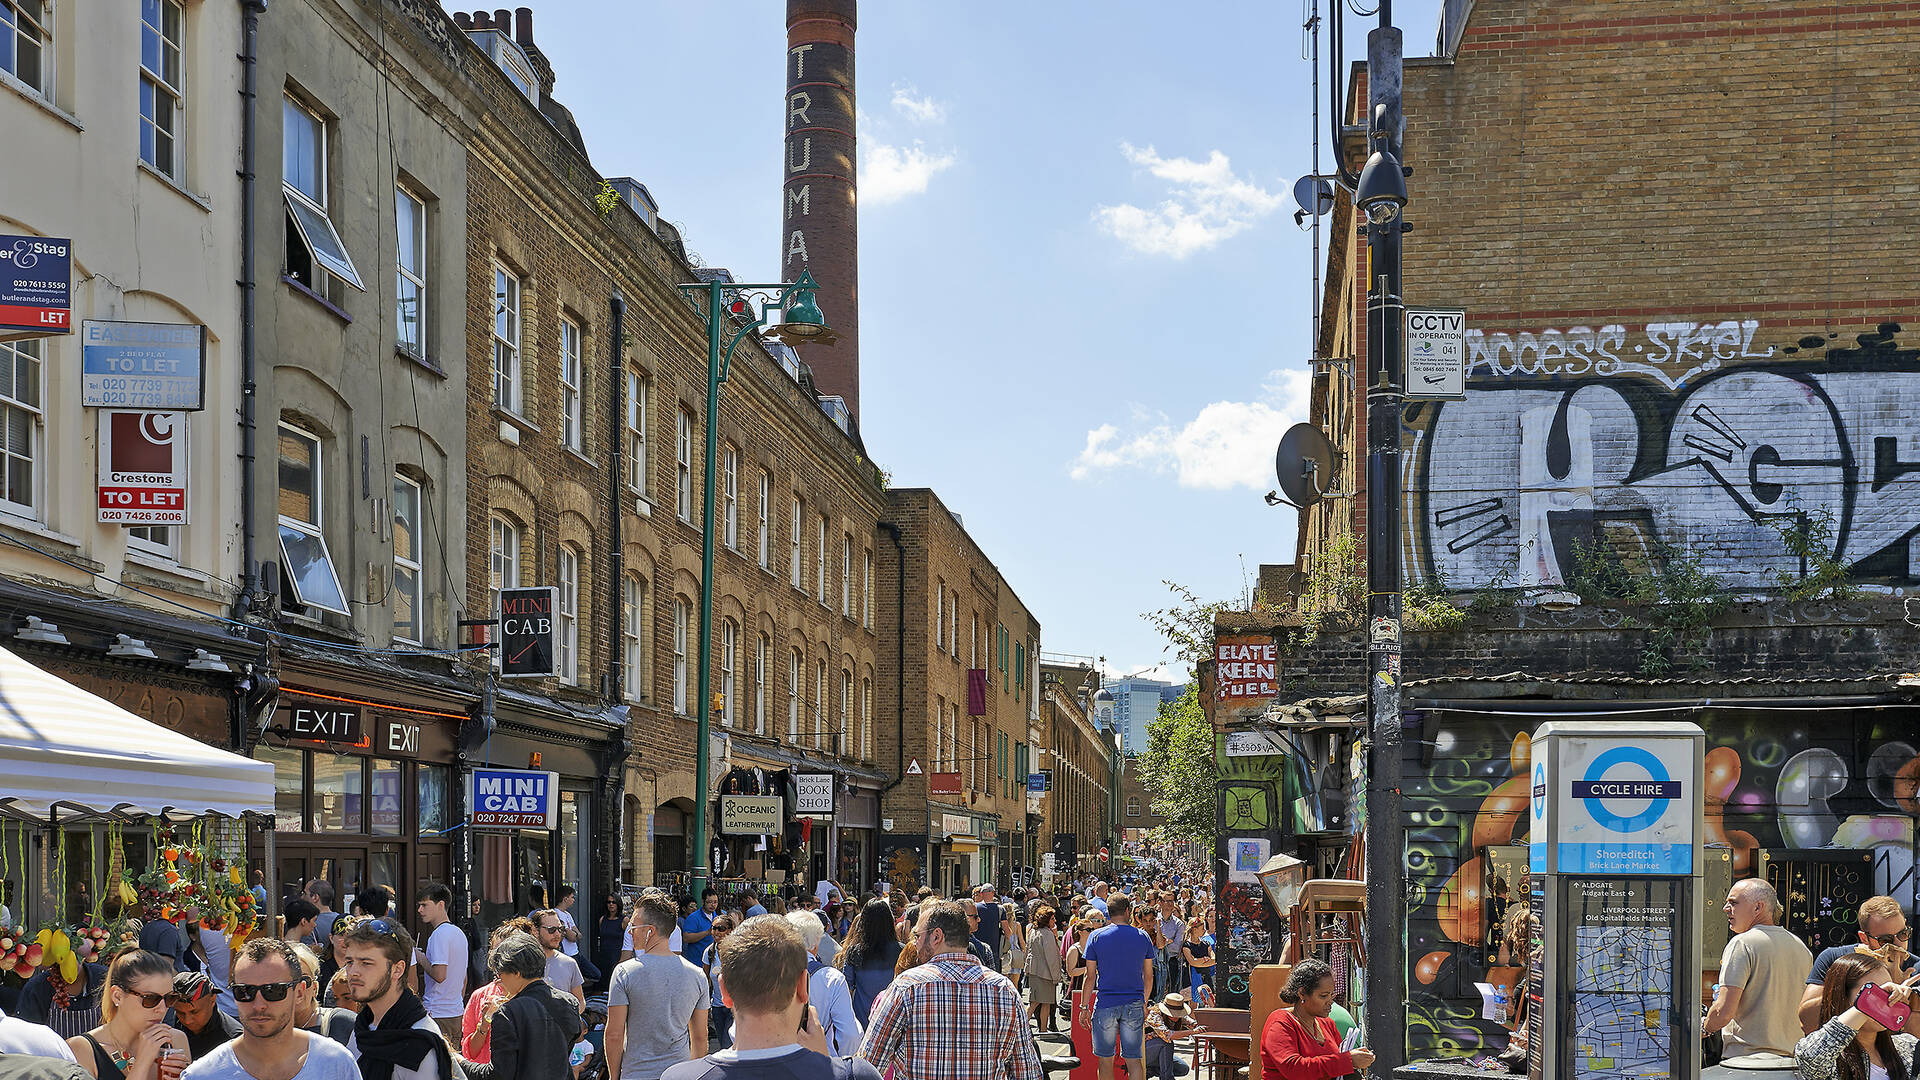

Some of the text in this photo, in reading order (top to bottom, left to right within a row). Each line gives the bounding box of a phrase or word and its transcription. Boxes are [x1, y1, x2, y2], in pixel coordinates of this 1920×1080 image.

[786, 44, 813, 309] TRUMA
[34, 242, 67, 257] Stag
[13, 279, 66, 290] 020 7613 5550
[2, 293, 66, 304] butlerandstag.com
[40, 311, 65, 324] LET
[1410, 315, 1461, 331] CCTV
[1418, 332, 1462, 340] OPERATION
[1442, 345, 1457, 355] 041
[106, 358, 180, 373] TO LET
[102, 378, 127, 390] 020
[102, 391, 127, 404] 020
[111, 473, 172, 484] Crestons
[103, 491, 180, 505] TO LET
[102, 511, 182, 521] 020 7426 2006
[502, 597, 551, 615] MINI
[504, 618, 551, 635] CAB
[1217, 662, 1275, 680] KEEN
[295, 709, 355, 735] EXIT
[479, 777, 544, 796] MINI
[799, 785, 829, 795] BOOK
[1590, 784, 1663, 795] CYCLE HIRE
[484, 795, 538, 812] CAB
[799, 798, 830, 808] SHOP
[736, 805, 776, 814] OCEANIC
[477, 813, 544, 824] 020 7247 7779
[725, 821, 775, 829] LEATHERWEAR
[1596, 849, 1655, 860] Shoreditch
[1589, 861, 1660, 870] Brick Lane Market
[1581, 890, 1609, 898] Aldgate
[1600, 914, 1641, 923] Spitalfields
[1641, 914, 1666, 922] Market
